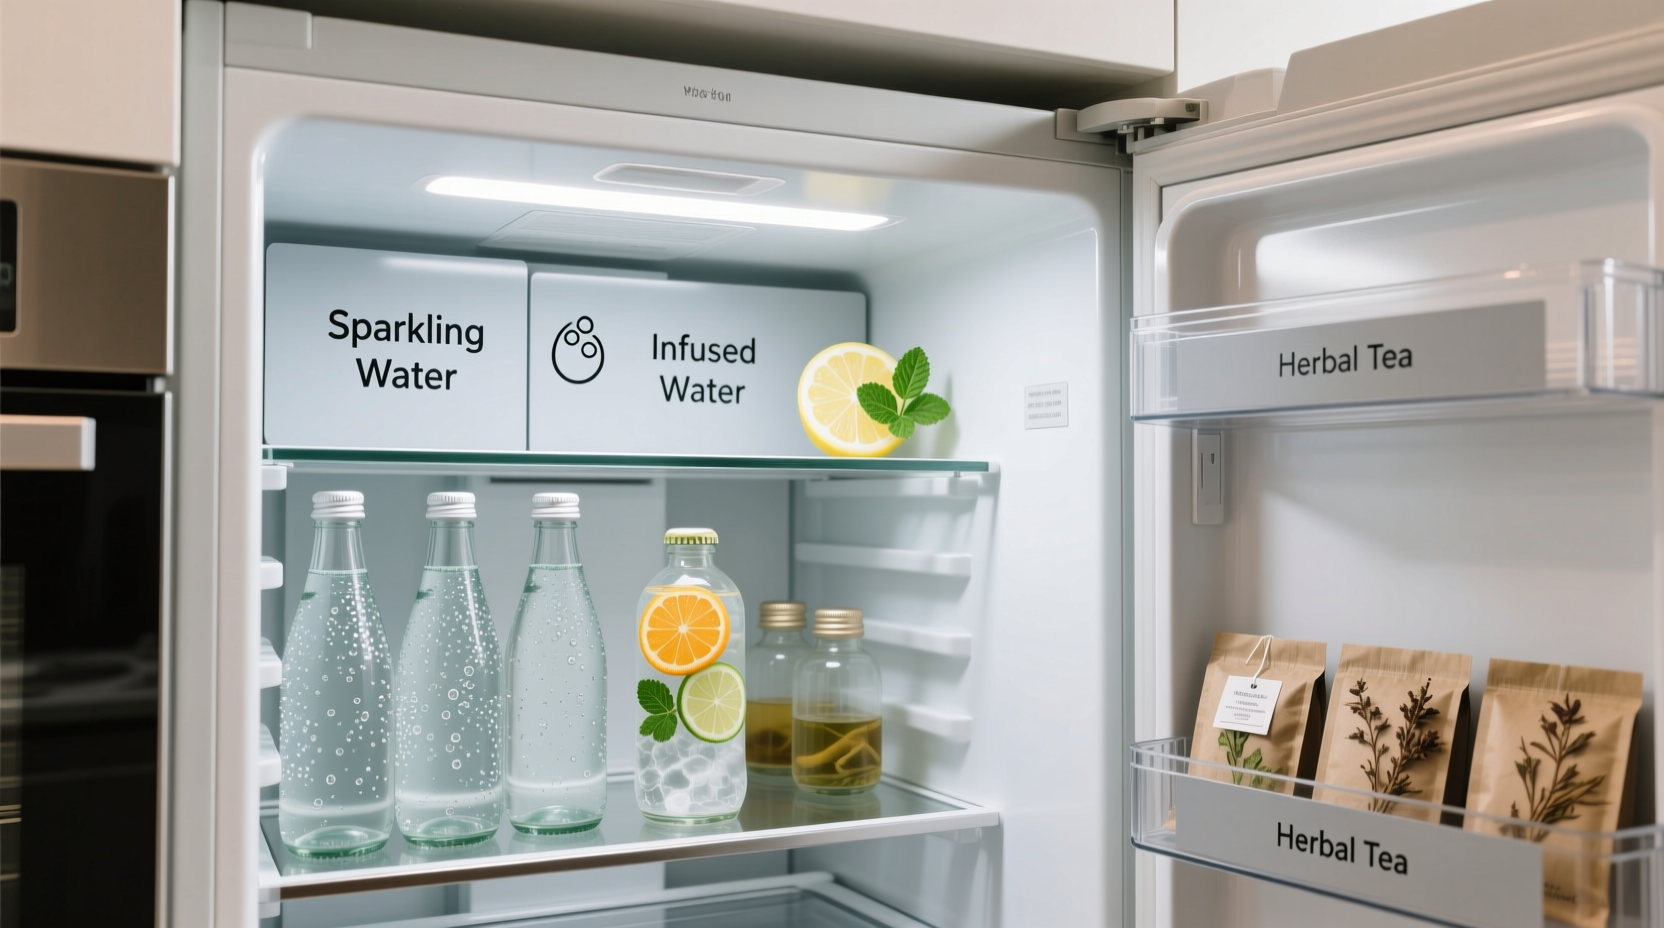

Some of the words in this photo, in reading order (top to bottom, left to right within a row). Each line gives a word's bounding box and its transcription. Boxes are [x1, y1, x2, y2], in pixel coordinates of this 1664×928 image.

[327, 308, 484, 354] Sparkling
[652, 333, 756, 364] Infused
[1279, 344, 1358, 377] Herbal
[1367, 343, 1413, 370] Tea
[355, 357, 458, 390] Water
[659, 374, 746, 404] Water
[1277, 821, 1355, 864] Herbal
[1363, 840, 1408, 876] Tea
